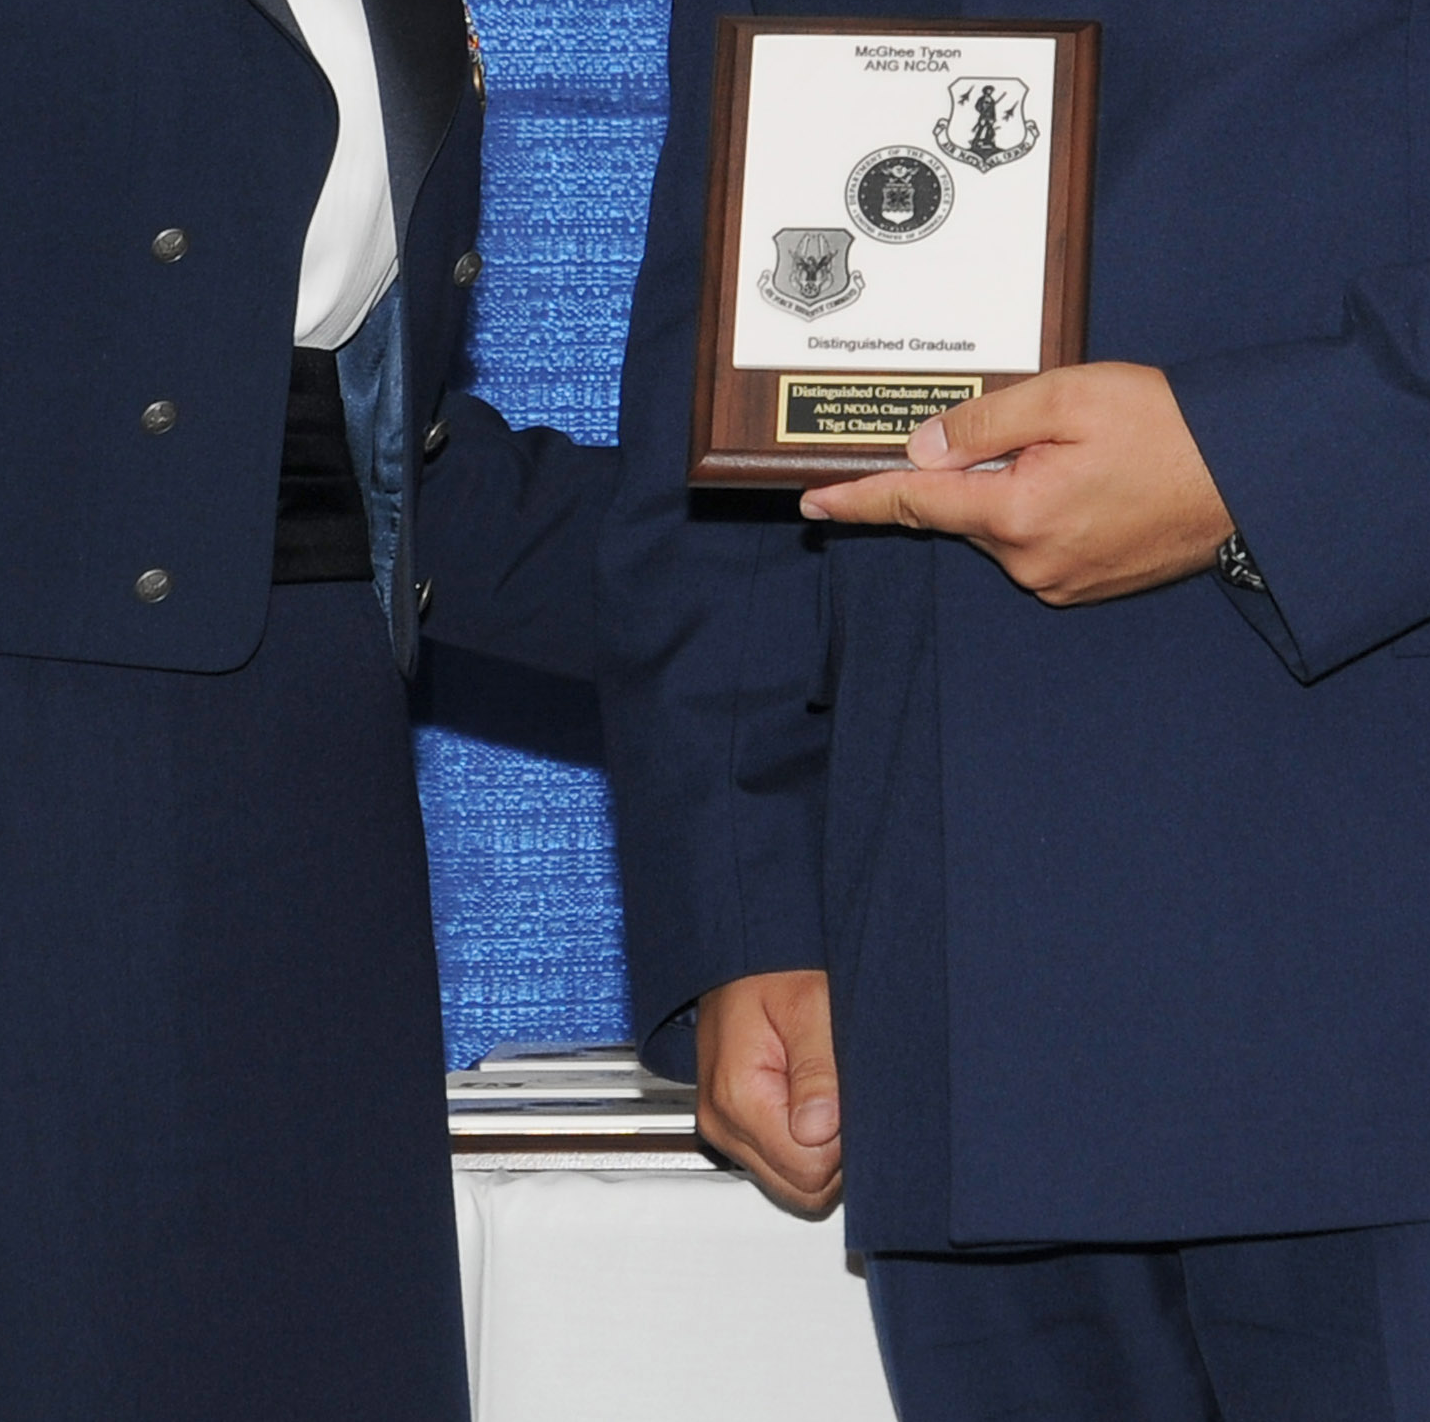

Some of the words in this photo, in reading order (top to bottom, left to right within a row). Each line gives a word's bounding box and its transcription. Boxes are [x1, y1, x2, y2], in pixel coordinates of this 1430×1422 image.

[854, 45, 915, 58] McGhee
[920, 46, 962, 60] Tyson
[864, 59, 899, 72] ANG
[903, 60, 950, 72] NCOA
[807, 335, 905, 354] Distinguished
[908, 338, 976, 353] Graduate
[791, 385, 873, 400] Distinguished
[874, 386, 929, 399] Graduate
[930, 386, 970, 399] Award
[813, 403, 841, 415] ANG
[843, 403, 879, 415] NCOA
[880, 404, 908, 415] Class
[816, 418, 846, 433] TSgt
[847, 419, 893, 431] Charles
